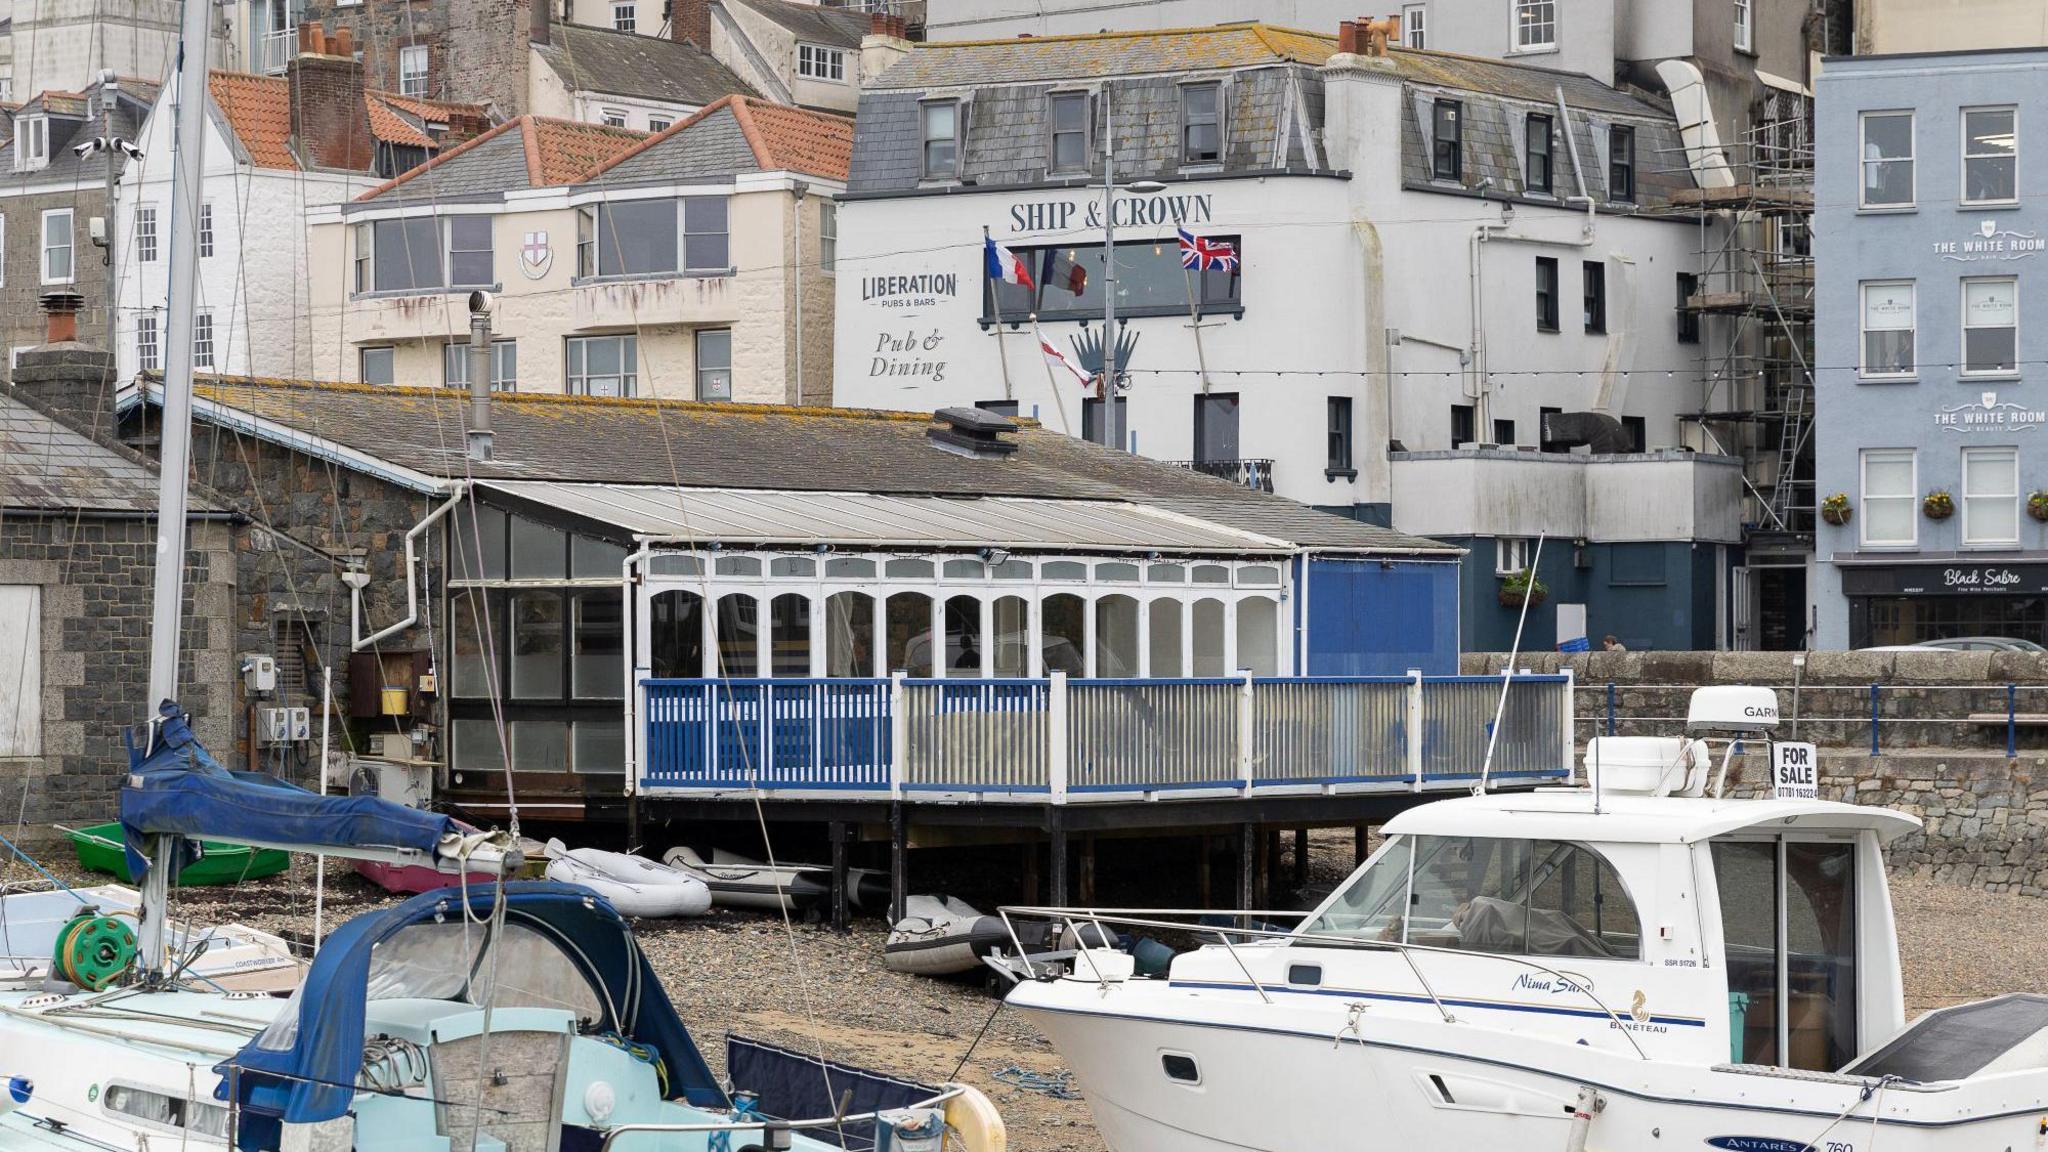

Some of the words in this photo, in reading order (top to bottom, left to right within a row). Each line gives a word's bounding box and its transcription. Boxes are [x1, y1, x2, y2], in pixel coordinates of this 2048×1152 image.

[1011, 202, 1076, 232] SHIP
[1085, 200, 1101, 228] &
[1112, 194, 1212, 226] CROWN
[1932, 242, 1957, 253] THE
[1963, 240, 2004, 252] WHITE
[2010, 239, 2046, 251] ROOM
[862, 272, 956, 301] LIBERATION
[882, 300, 904, 308] PUBS
[914, 298, 936, 307] BARS
[875, 330, 918, 352] Pub
[923, 328, 945, 351] &
[869, 357, 948, 382] Dining
[1934, 413, 1957, 425] THE
[1964, 412, 2005, 424] WHITE
[2011, 411, 2046, 423] ROOM
[1944, 568, 1980, 586] Black
[1984, 568, 2020, 586] Sabre
[1782, 747, 1808, 765] FOR
[1780, 766, 1812, 784] SALE
[1664, 959, 1678, 967] SSR
[1512, 973, 1550, 991] Nima
[1826, 1142, 1854, 1152] 760
